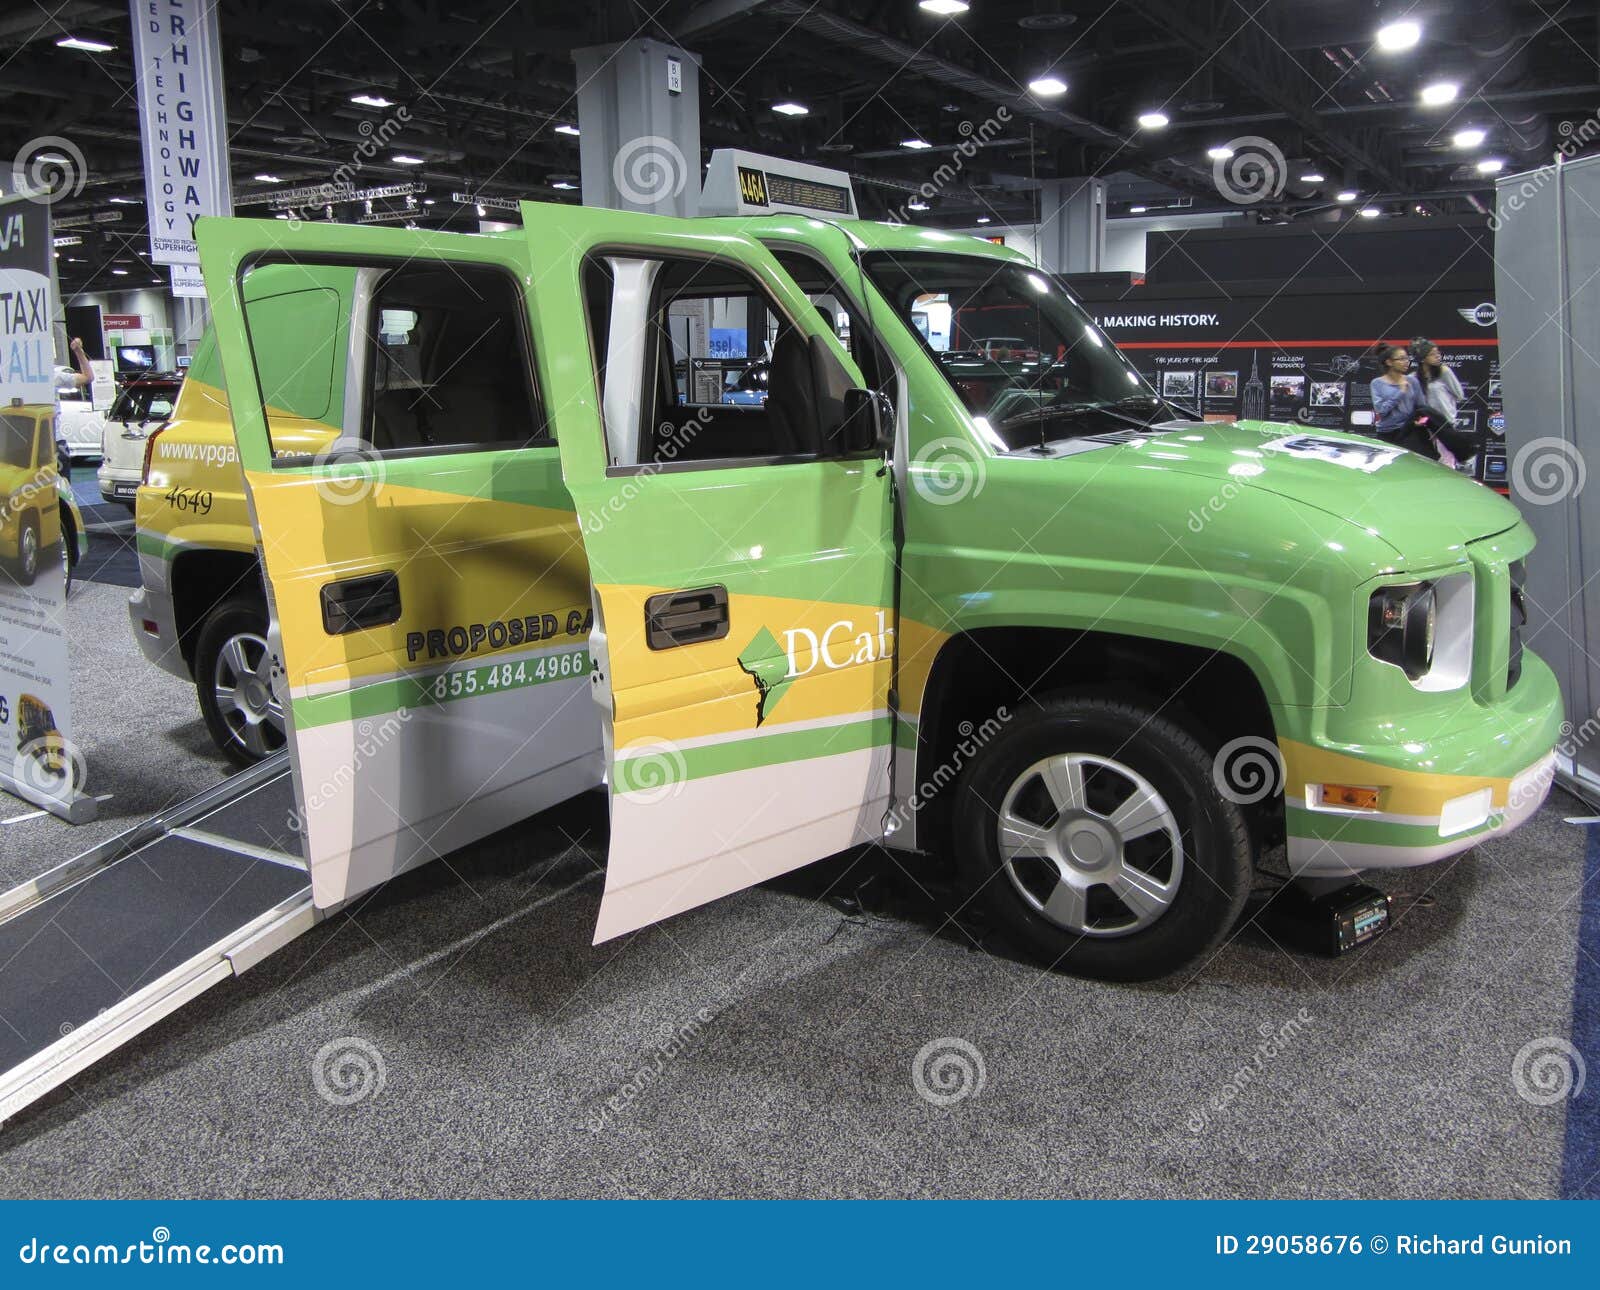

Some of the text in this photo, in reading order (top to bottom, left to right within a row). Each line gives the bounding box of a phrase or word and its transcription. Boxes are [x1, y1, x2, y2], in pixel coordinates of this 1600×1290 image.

[153, 57, 175, 231] TECHNOLOGY
[0, 288, 47, 335] TAXI
[1103, 315, 1157, 328] MAKING
[1159, 313, 1220, 327] HISTORY.
[1477, 311, 1495, 319] MINI
[8, 339, 49, 384] ALL
[165, 486, 213, 515] 4649
[406, 613, 558, 661] PROPOSED
[434, 652, 583, 699] 855.484.4966
